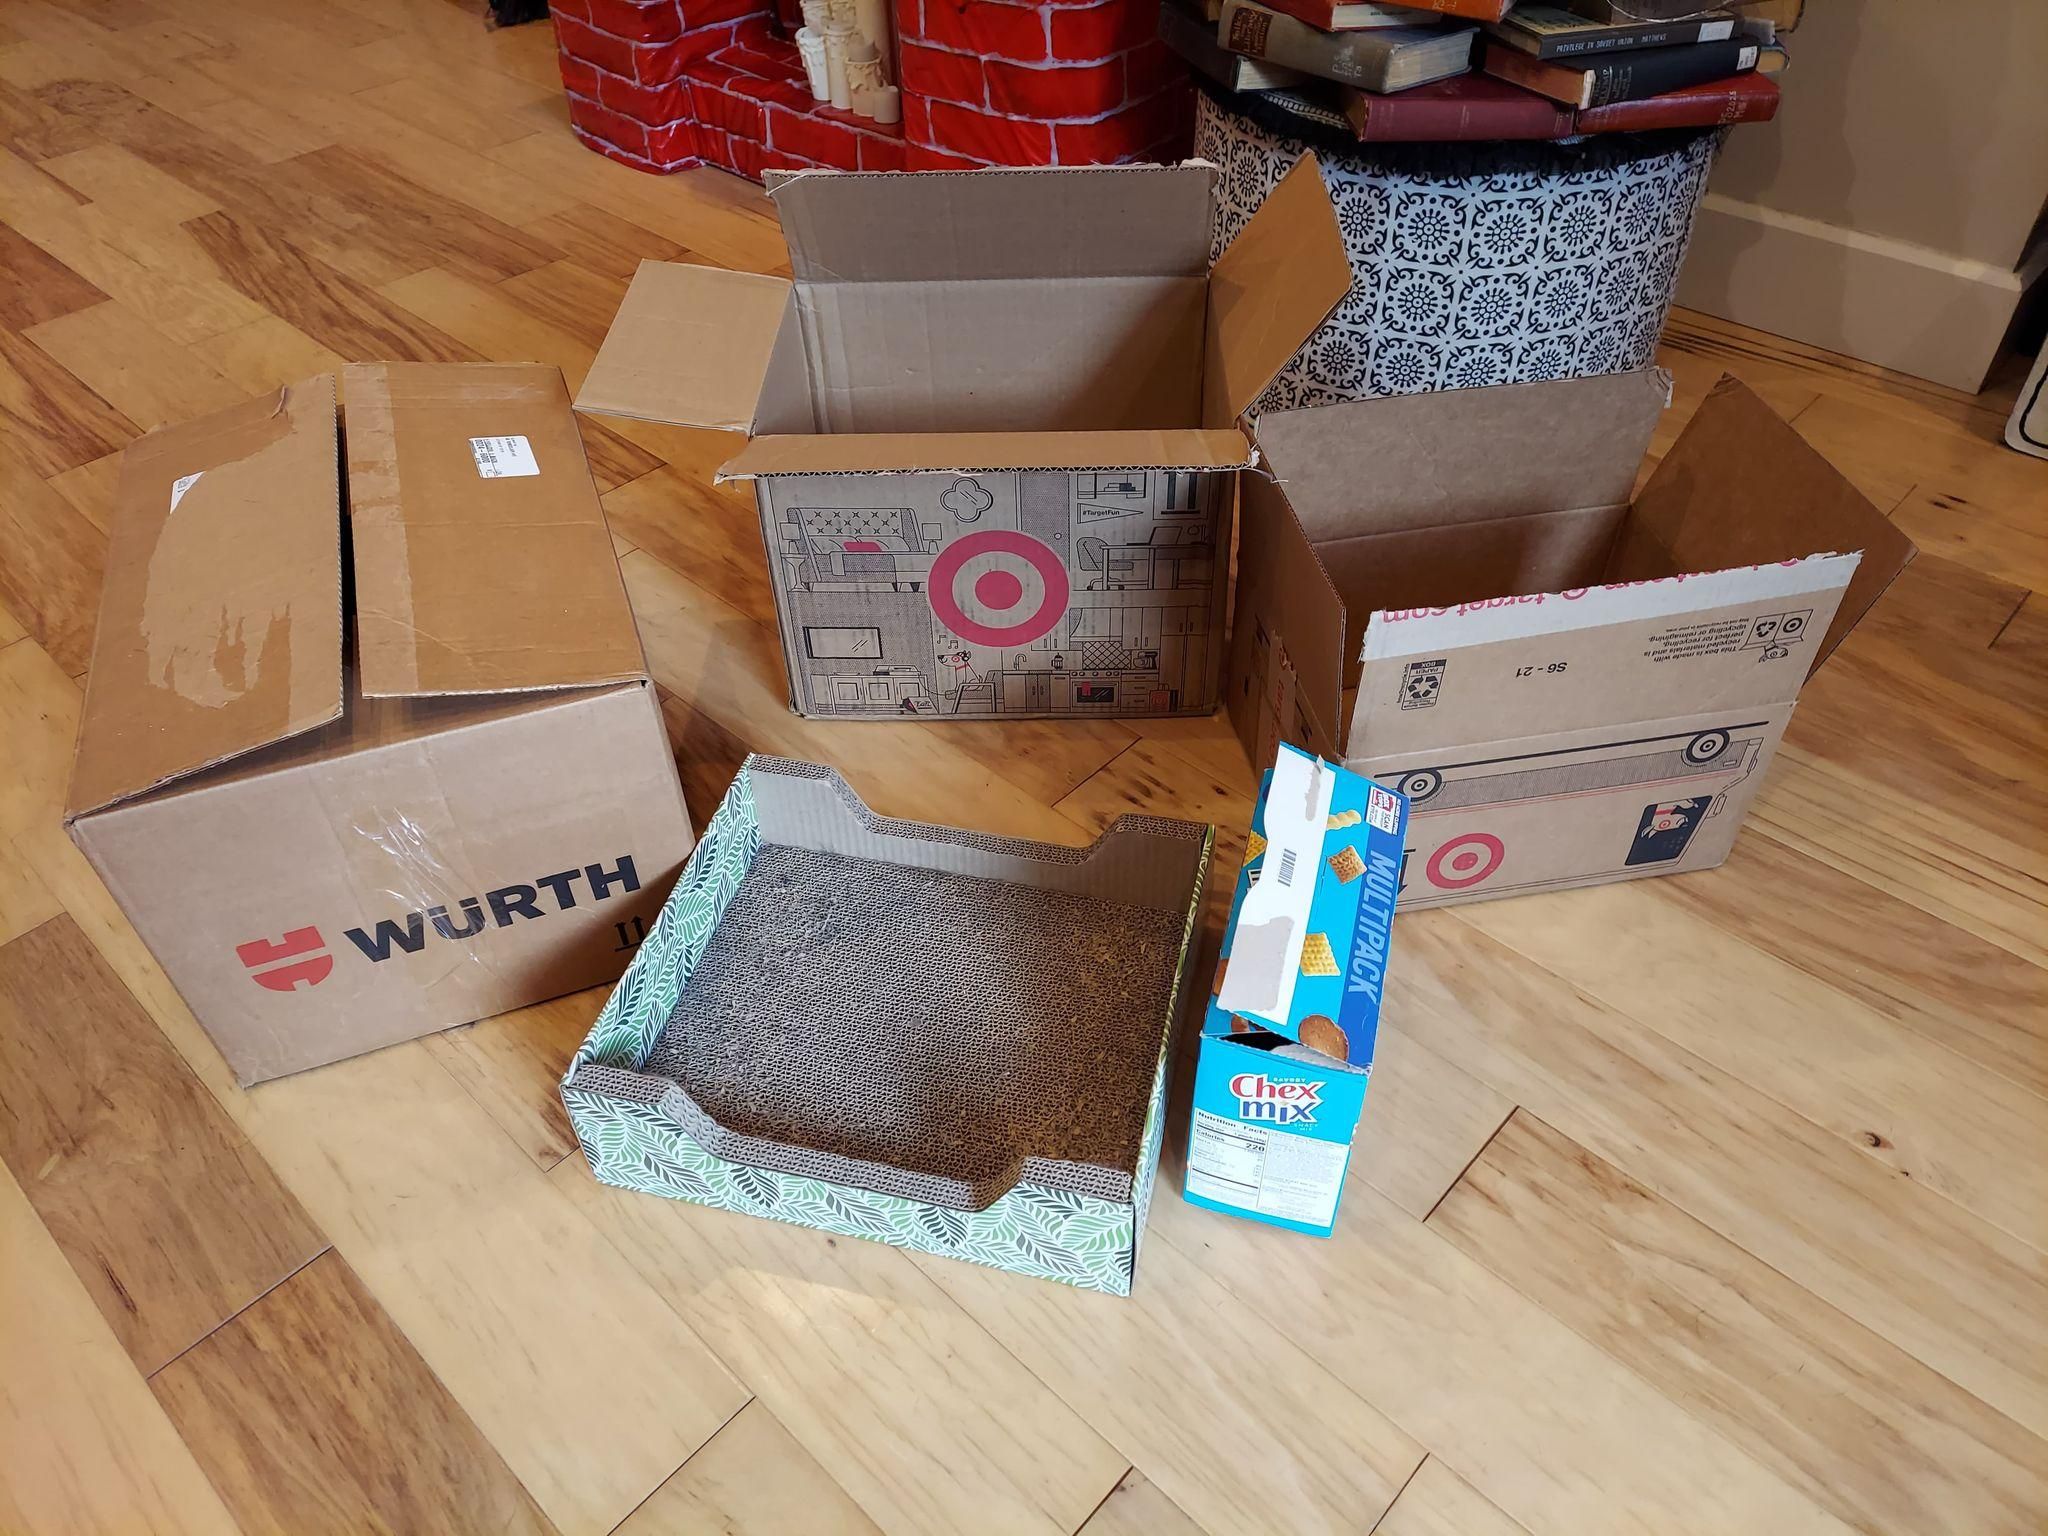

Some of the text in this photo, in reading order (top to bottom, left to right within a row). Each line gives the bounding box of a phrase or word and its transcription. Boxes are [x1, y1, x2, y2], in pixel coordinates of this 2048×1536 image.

[1556, 42, 1585, 54] PRIVILEGE
[1596, 38, 1616, 49] SOVIET
[1617, 37, 1634, 47] UNION
[1082, 509, 1120, 517] #TargetFun
[1707, 624, 1747, 635] upcycling
[1714, 630, 1745, 641] perfect
[1701, 635, 1714, 643] for
[1706, 638, 1741, 649] recycled
[1669, 644, 1706, 653] materials
[1672, 651, 1695, 659] made
[1720, 645, 1737, 653] This
[1653, 655, 1671, 663] with
[1514, 665, 1534, 678] 21
[1547, 661, 1569, 674] S6
[1383, 813, 1391, 830] SCAN
[343, 855, 641, 963] WÜRTH
[1348, 850, 1396, 1004] MULTIPACK
[1231, 1074, 1320, 1100] Chex
[1242, 1100, 1317, 1123] mix
[1198, 1111, 1268, 1136] Nutrition Facts
[1196, 1128, 1265, 1152] Calories 220
